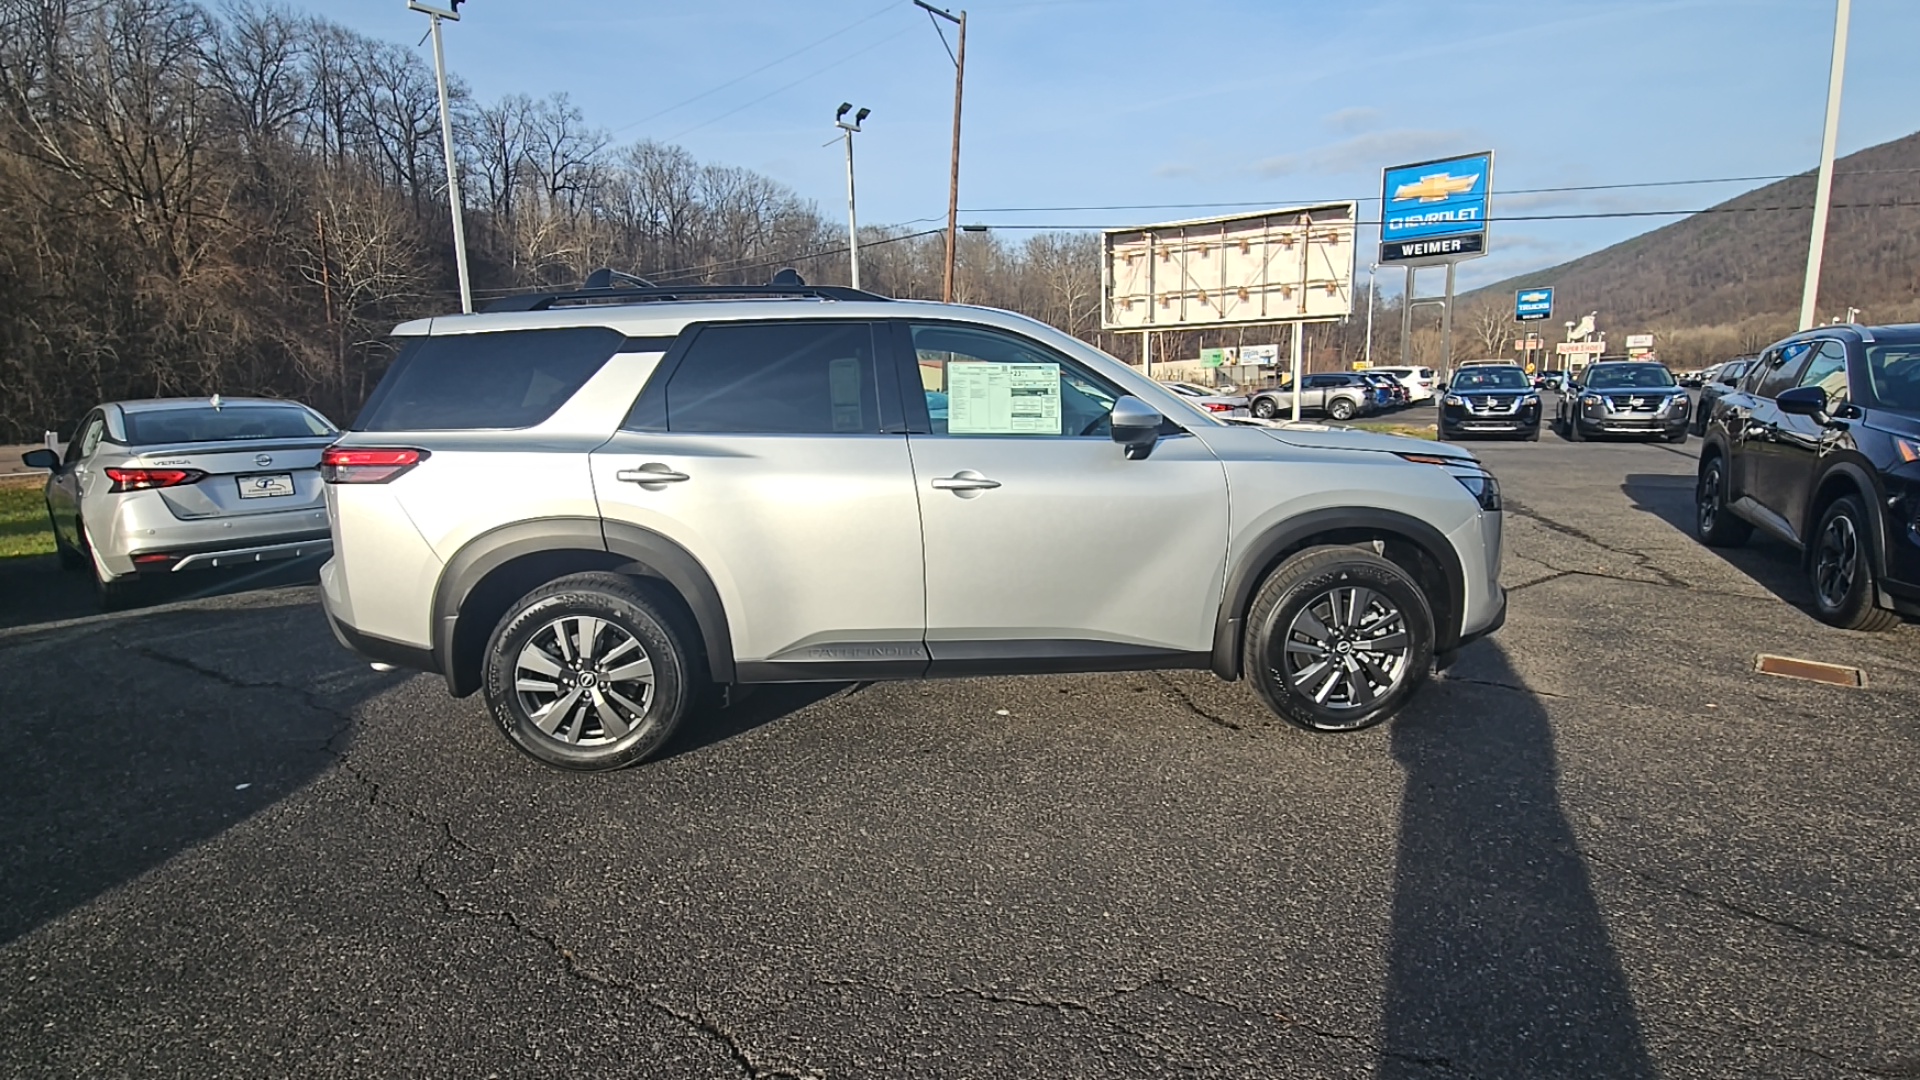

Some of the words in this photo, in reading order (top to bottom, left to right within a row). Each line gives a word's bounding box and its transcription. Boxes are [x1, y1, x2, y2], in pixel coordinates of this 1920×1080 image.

[1389, 207, 1479, 230] CHEVROLET
[1401, 240, 1461, 256] WEIMER
[1518, 302, 1550, 311] TRUCKS
